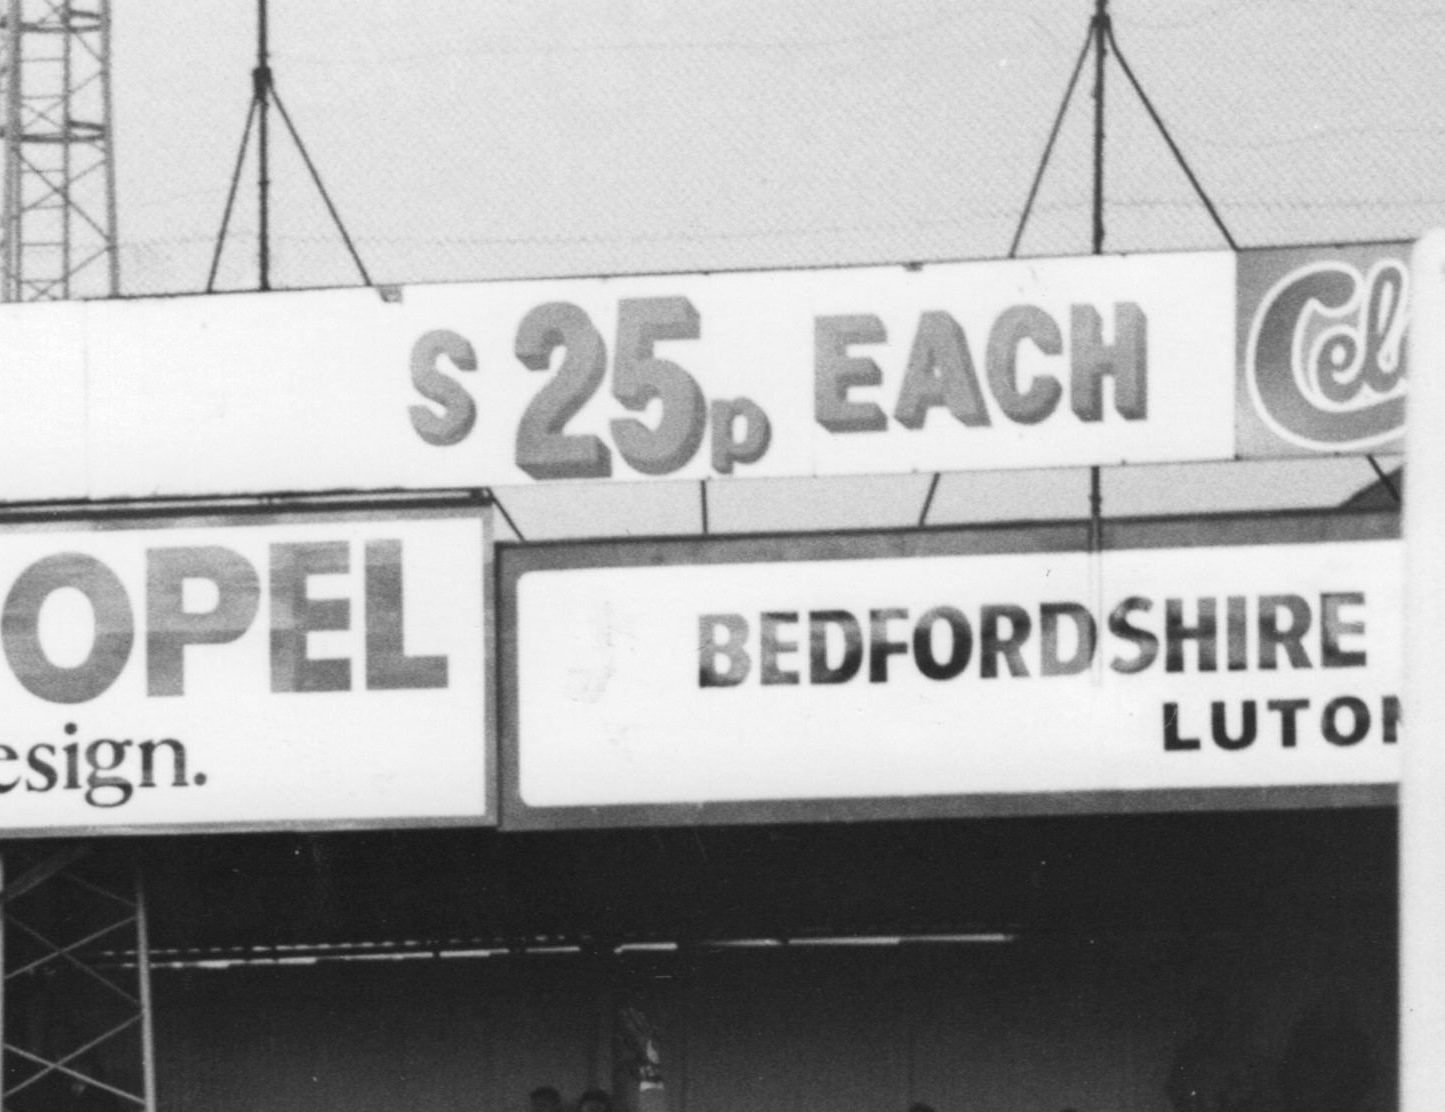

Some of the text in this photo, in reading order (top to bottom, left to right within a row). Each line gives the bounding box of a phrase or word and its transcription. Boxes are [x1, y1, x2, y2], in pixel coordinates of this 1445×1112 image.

[409, 296, 1147, 480] S 25p EACH
[1246, 258, 1408, 450] Cel
[698, 592, 1367, 688] BEDFORDSHIRE
